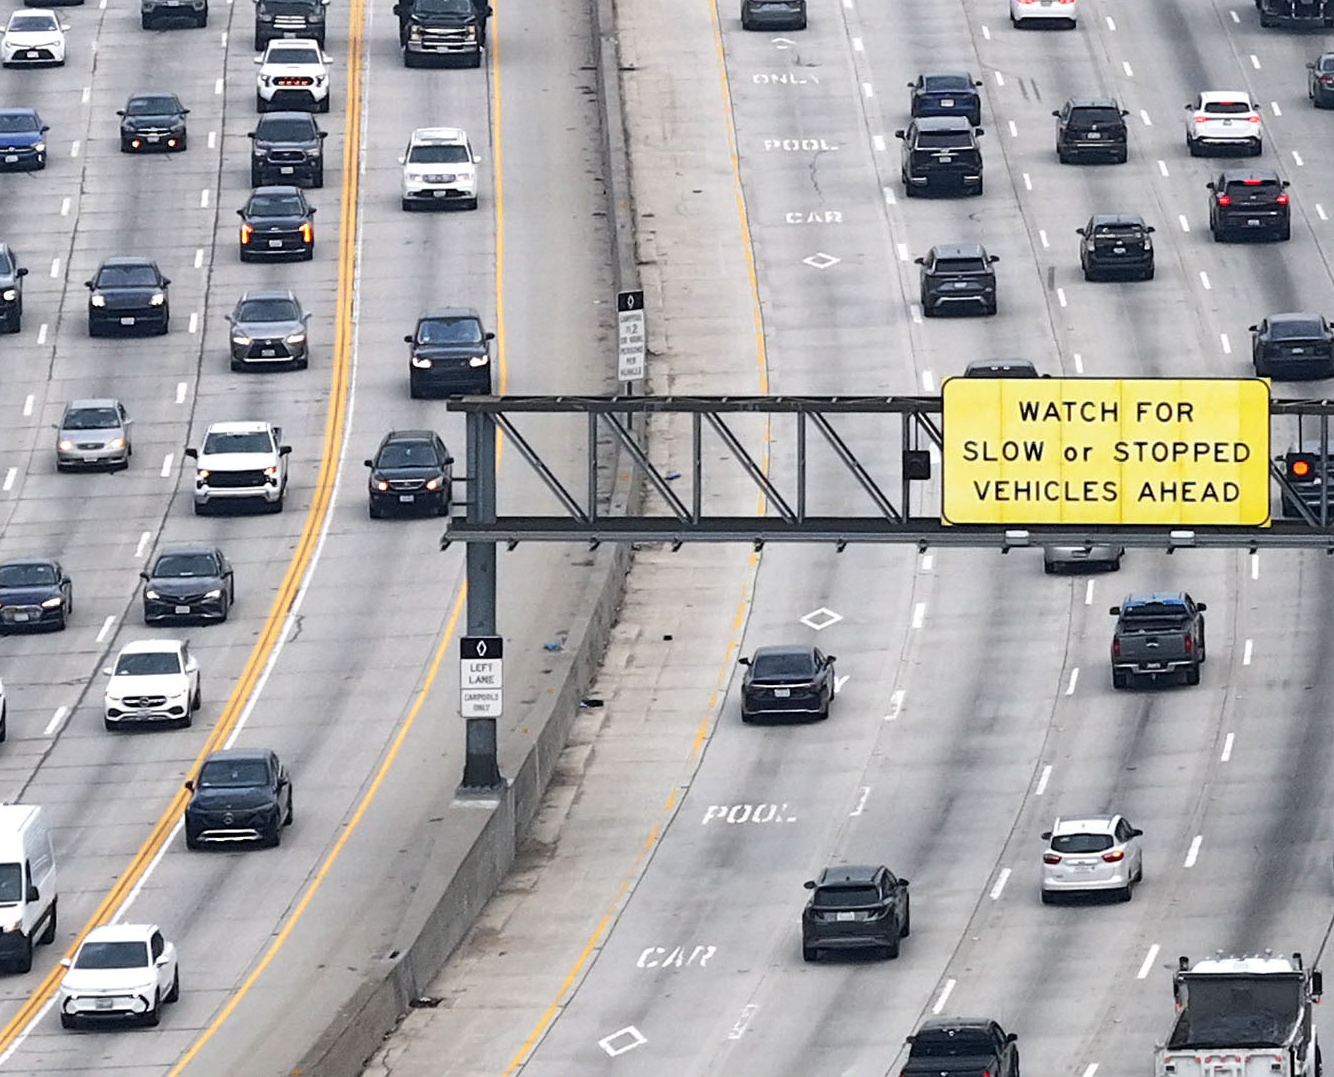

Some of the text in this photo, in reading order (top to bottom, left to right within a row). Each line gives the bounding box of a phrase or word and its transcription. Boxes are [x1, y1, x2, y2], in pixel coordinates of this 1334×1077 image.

[752, 73, 819, 85] ONLY
[764, 138, 839, 151] POOL
[785, 210, 844, 224] CAR
[632, 324, 638, 334] 2
[1019, 401, 1194, 423] WATCH FOR
[963, 440, 1251, 463] SLOW or STOPPED
[973, 480, 1240, 502] VEHICLES AHEAD
[470, 663, 493, 673] LEFT
[468, 676, 495, 684] LANE
[464, 693, 499, 701] CARPOOLS
[702, 803, 797, 825] POOL
[636, 944, 717, 969] CAR
